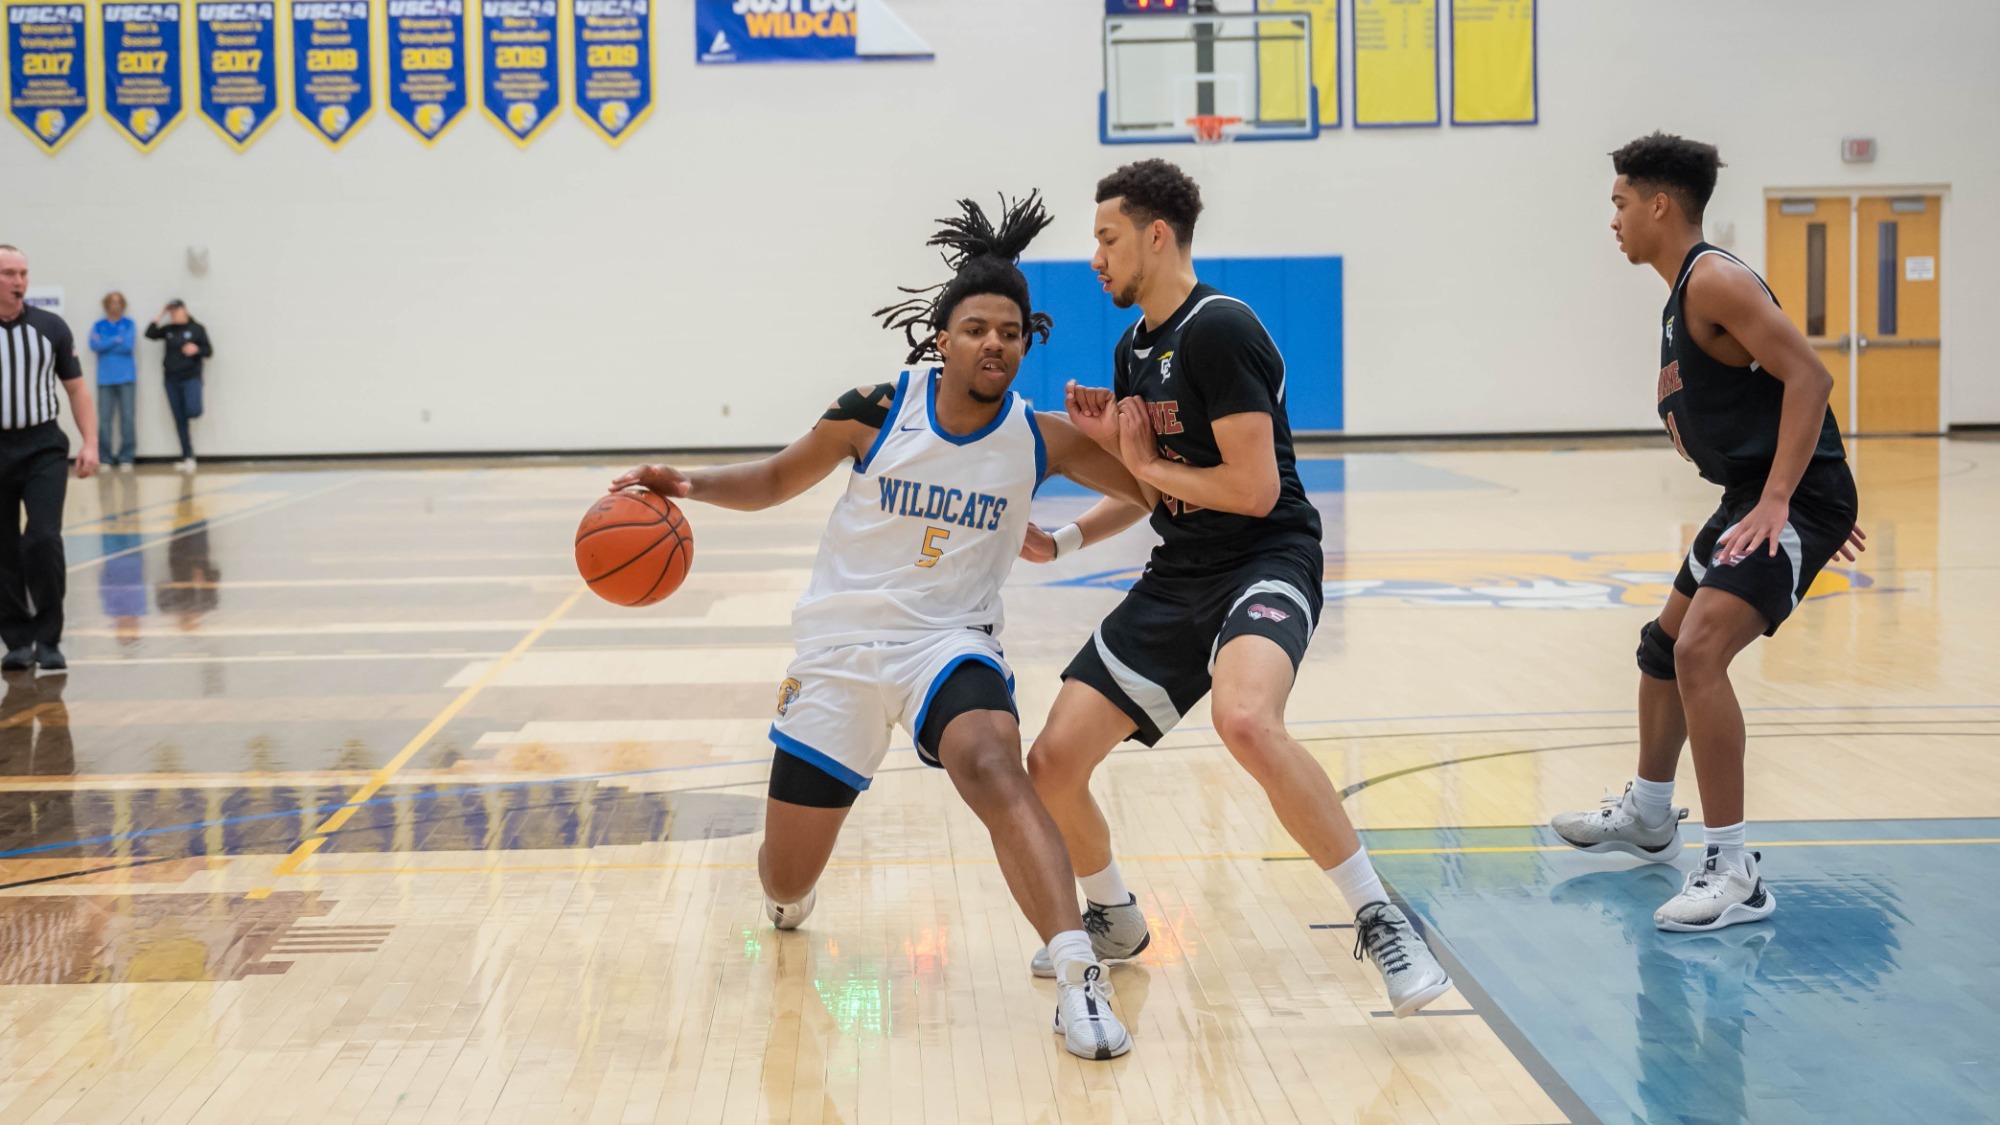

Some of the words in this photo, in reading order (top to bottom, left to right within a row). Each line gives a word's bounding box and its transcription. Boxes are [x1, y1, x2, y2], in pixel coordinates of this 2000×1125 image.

[22, 53, 73, 75] 2017
[117, 51, 168, 73] 2017
[212, 50, 263, 72] 2017
[306, 49, 358, 71] 2018
[402, 47, 453, 70] 2019
[495, 46, 546, 69] 2019
[587, 44, 638, 67] 2019
[879, 476, 1008, 531] WILDCATS
[915, 526, 951, 568] 5
